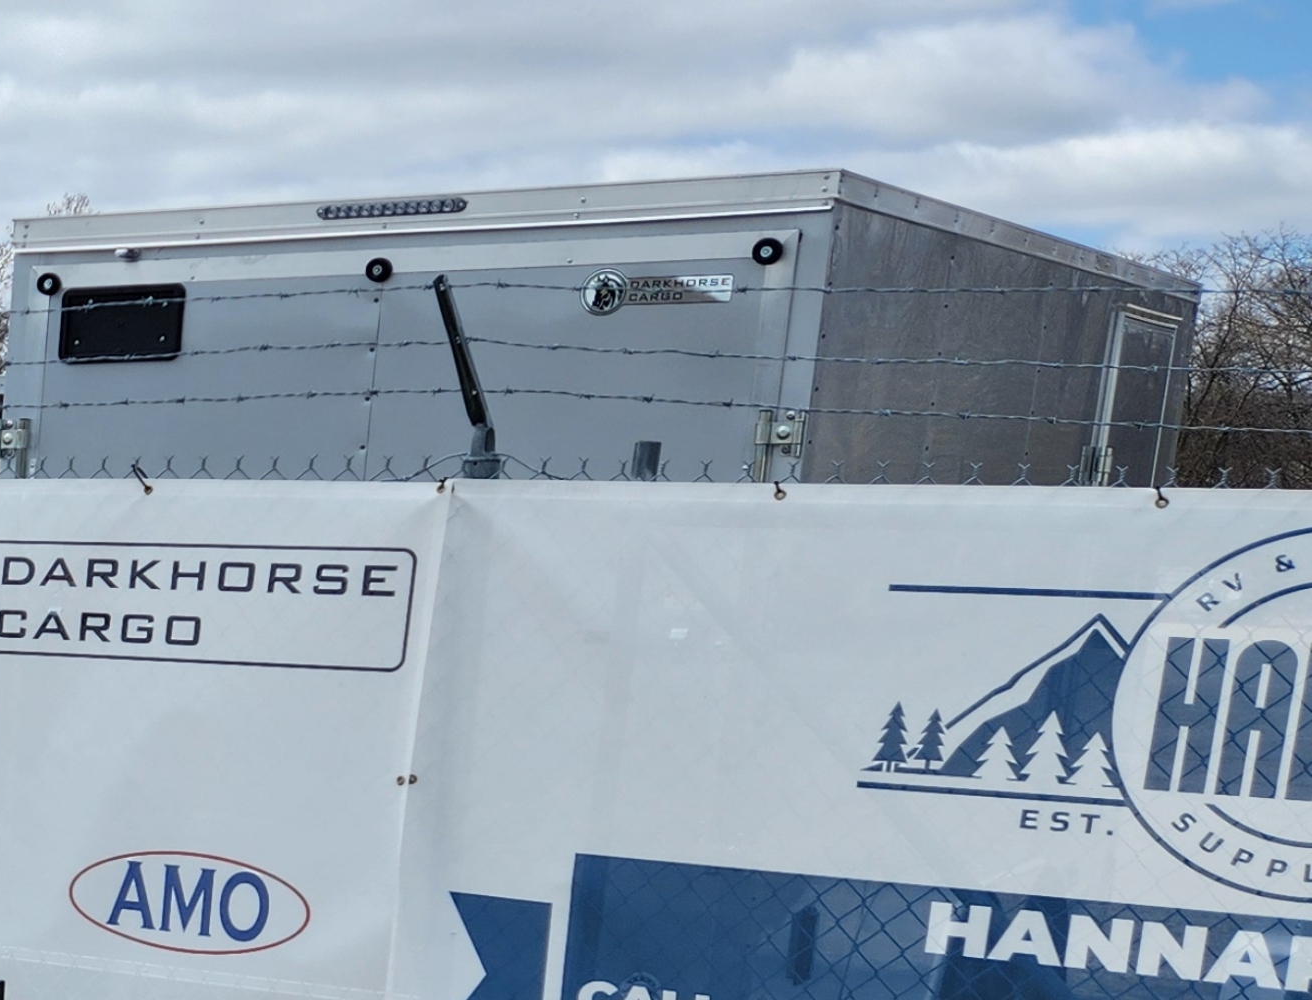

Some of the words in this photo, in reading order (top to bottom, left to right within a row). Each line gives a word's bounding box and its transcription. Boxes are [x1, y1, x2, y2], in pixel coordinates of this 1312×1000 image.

[628, 291, 683, 302] CARGO
[630, 278, 731, 289] DARKHORSE
[0, 556, 398, 597] DARKHORSE
[1195, 572, 1243, 612] RV
[1274, 554, 1295, 573] &
[1019, 808, 1114, 836] EST.
[105, 860, 270, 942] AMO
